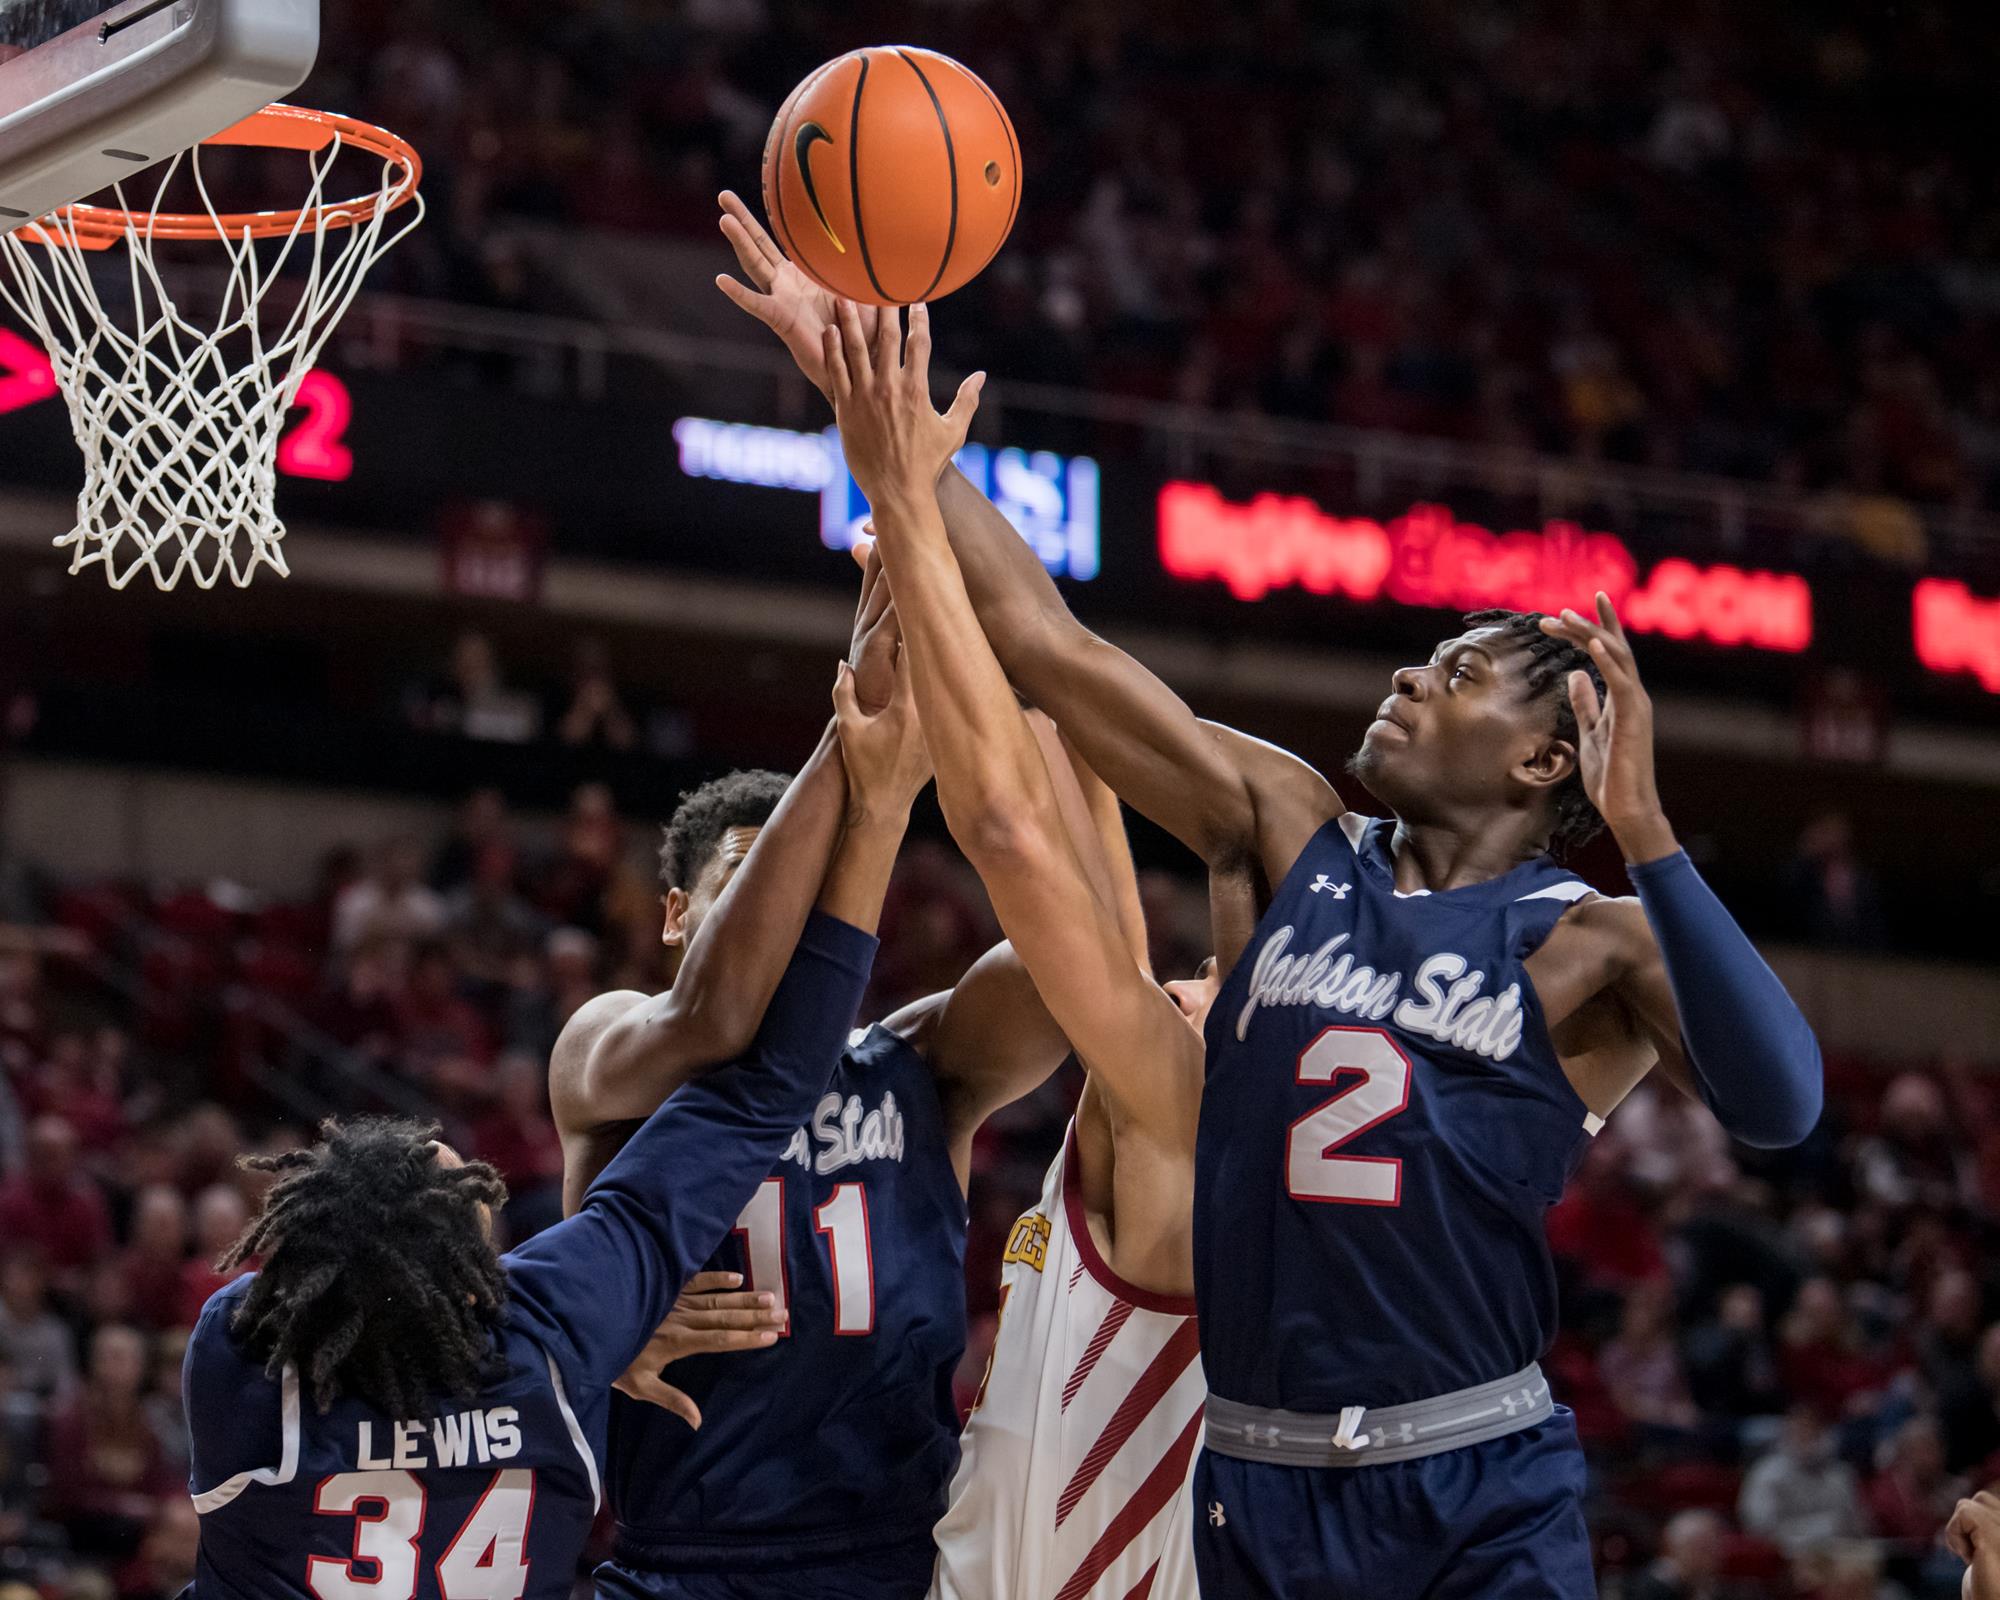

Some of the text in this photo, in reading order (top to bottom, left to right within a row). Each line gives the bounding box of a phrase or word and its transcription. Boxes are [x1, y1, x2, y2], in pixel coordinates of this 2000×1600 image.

[276, 367, 353, 482] 2
[1235, 925, 1524, 1062] Jackson State
[1284, 1026, 1412, 1208] 2
[731, 1176, 875, 1338] 11
[356, 1405, 522, 1471] LEWIS
[306, 1468, 537, 1600] 34
